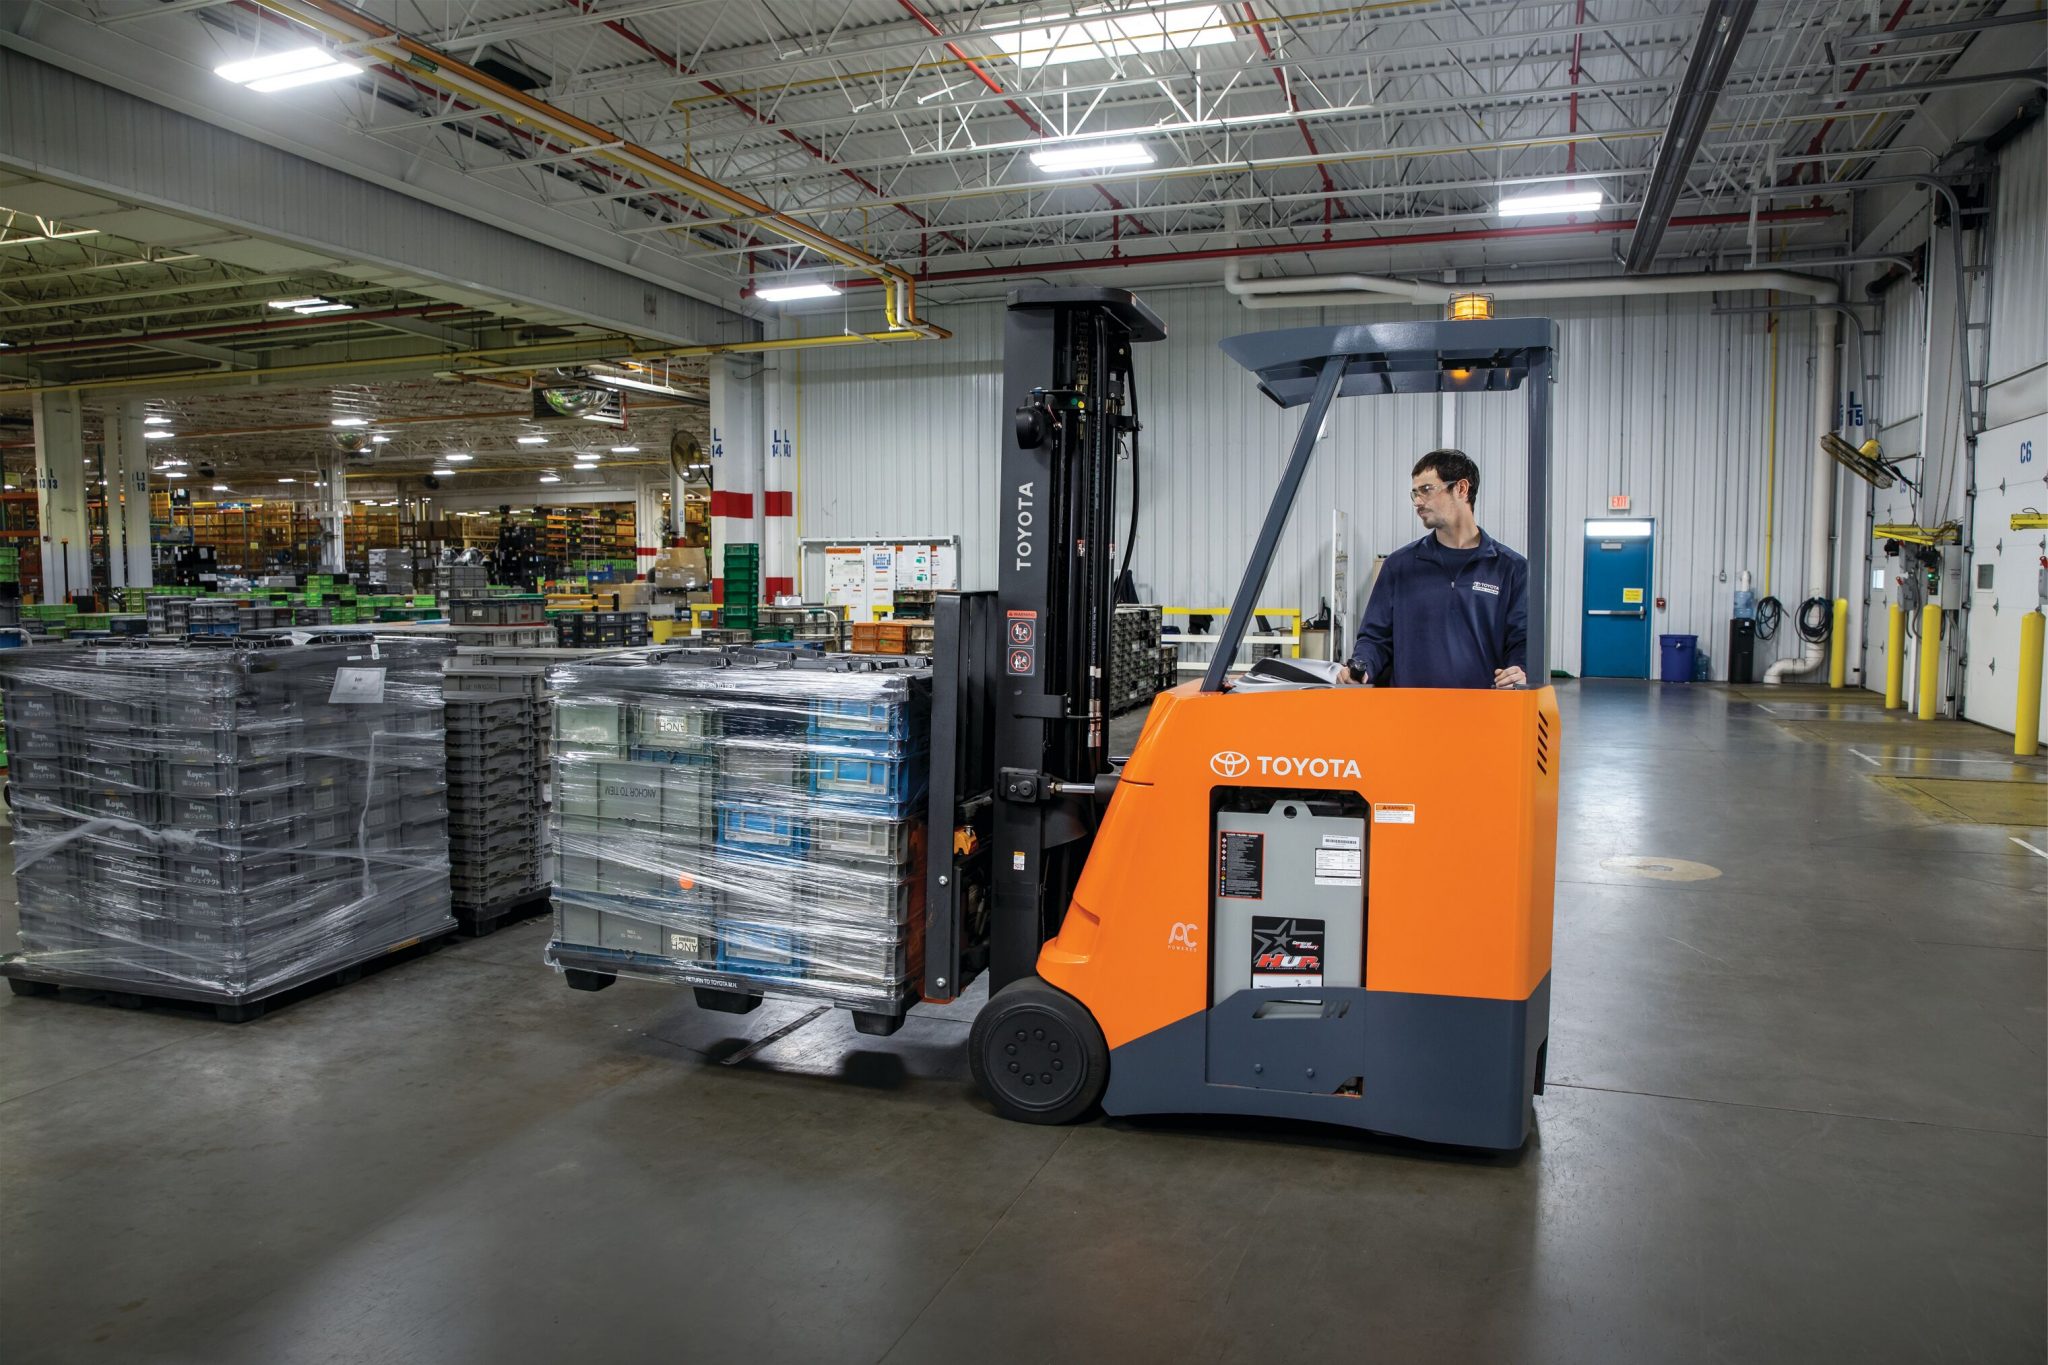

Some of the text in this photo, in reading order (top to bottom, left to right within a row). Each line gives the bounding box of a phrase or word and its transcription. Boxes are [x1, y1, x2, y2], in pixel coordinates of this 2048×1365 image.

[1850, 391, 1862, 408] L
[1847, 409, 1863, 427] 15
[714, 428, 722, 441] L
[774, 430, 781, 443] L
[785, 430, 789, 442] L
[712, 444, 723, 457] 14
[2020, 441, 2032, 463] C6
[50, 468, 54, 478] L
[39, 480, 46, 489] 13
[48, 480, 58, 489] 13
[137, 483, 146, 492] 13
[1611, 496, 1627, 508] EXIT
[1016, 481, 1034, 571] TOYOTA
[1257, 756, 1362, 778] TOYOTA
[605, 785, 656, 798] ANCHOR TO TIEM
[1168, 922, 1198, 948] AC
[672, 941, 697, 952] ANCH
